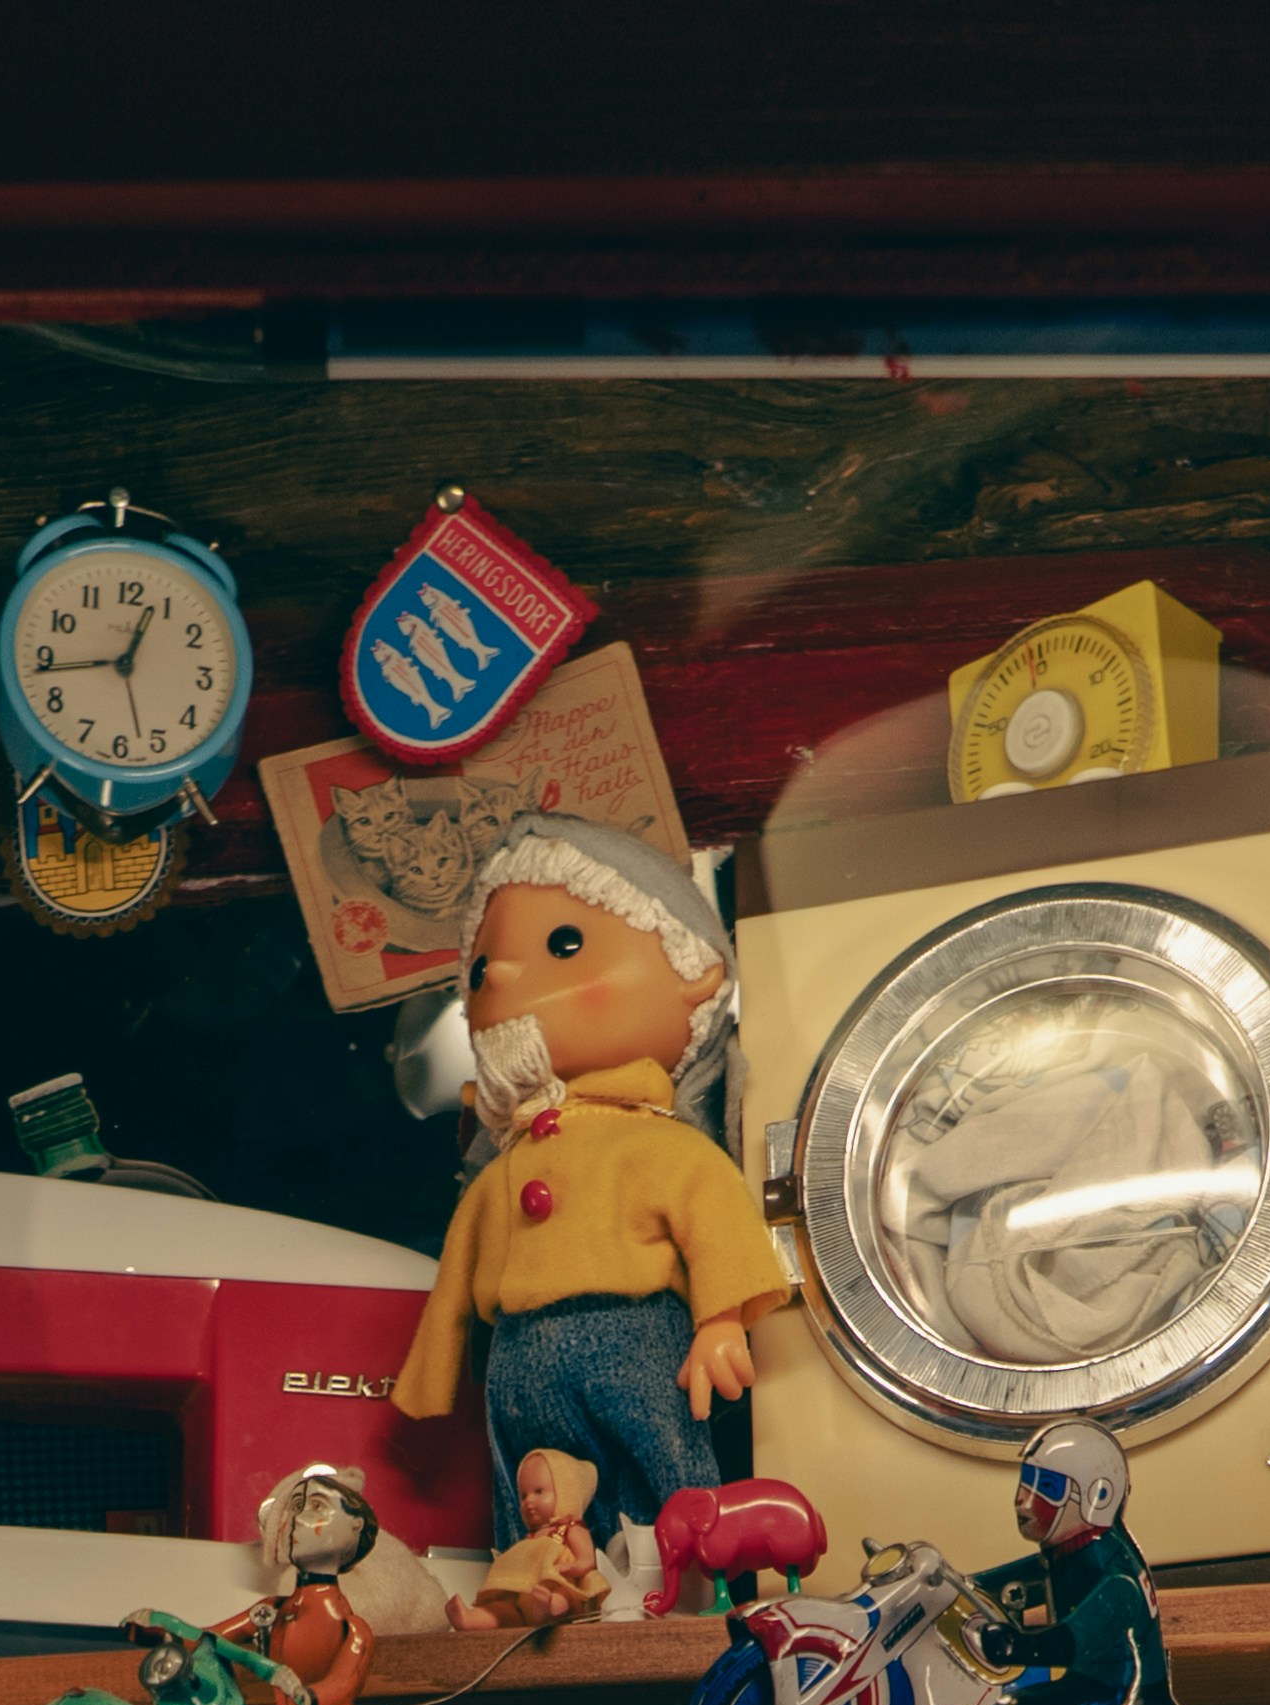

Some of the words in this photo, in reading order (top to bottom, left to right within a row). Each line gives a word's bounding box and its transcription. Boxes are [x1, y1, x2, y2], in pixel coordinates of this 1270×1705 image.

[118, 581, 145, 606] 12
[436, 528, 557, 636] HERINGSDORF
[81, 584, 100, 609] 11
[161, 597, 173, 620] 1
[51, 608, 76, 635] 10
[186, 623, 204, 649] 2
[36, 645, 54, 671] 9
[195, 666, 214, 691] 3
[46, 687, 64, 714] 8
[178, 704, 198, 731] 4
[77, 718, 95, 744] 7
[149, 729, 167, 754] 5
[112, 735, 129, 759] 6
